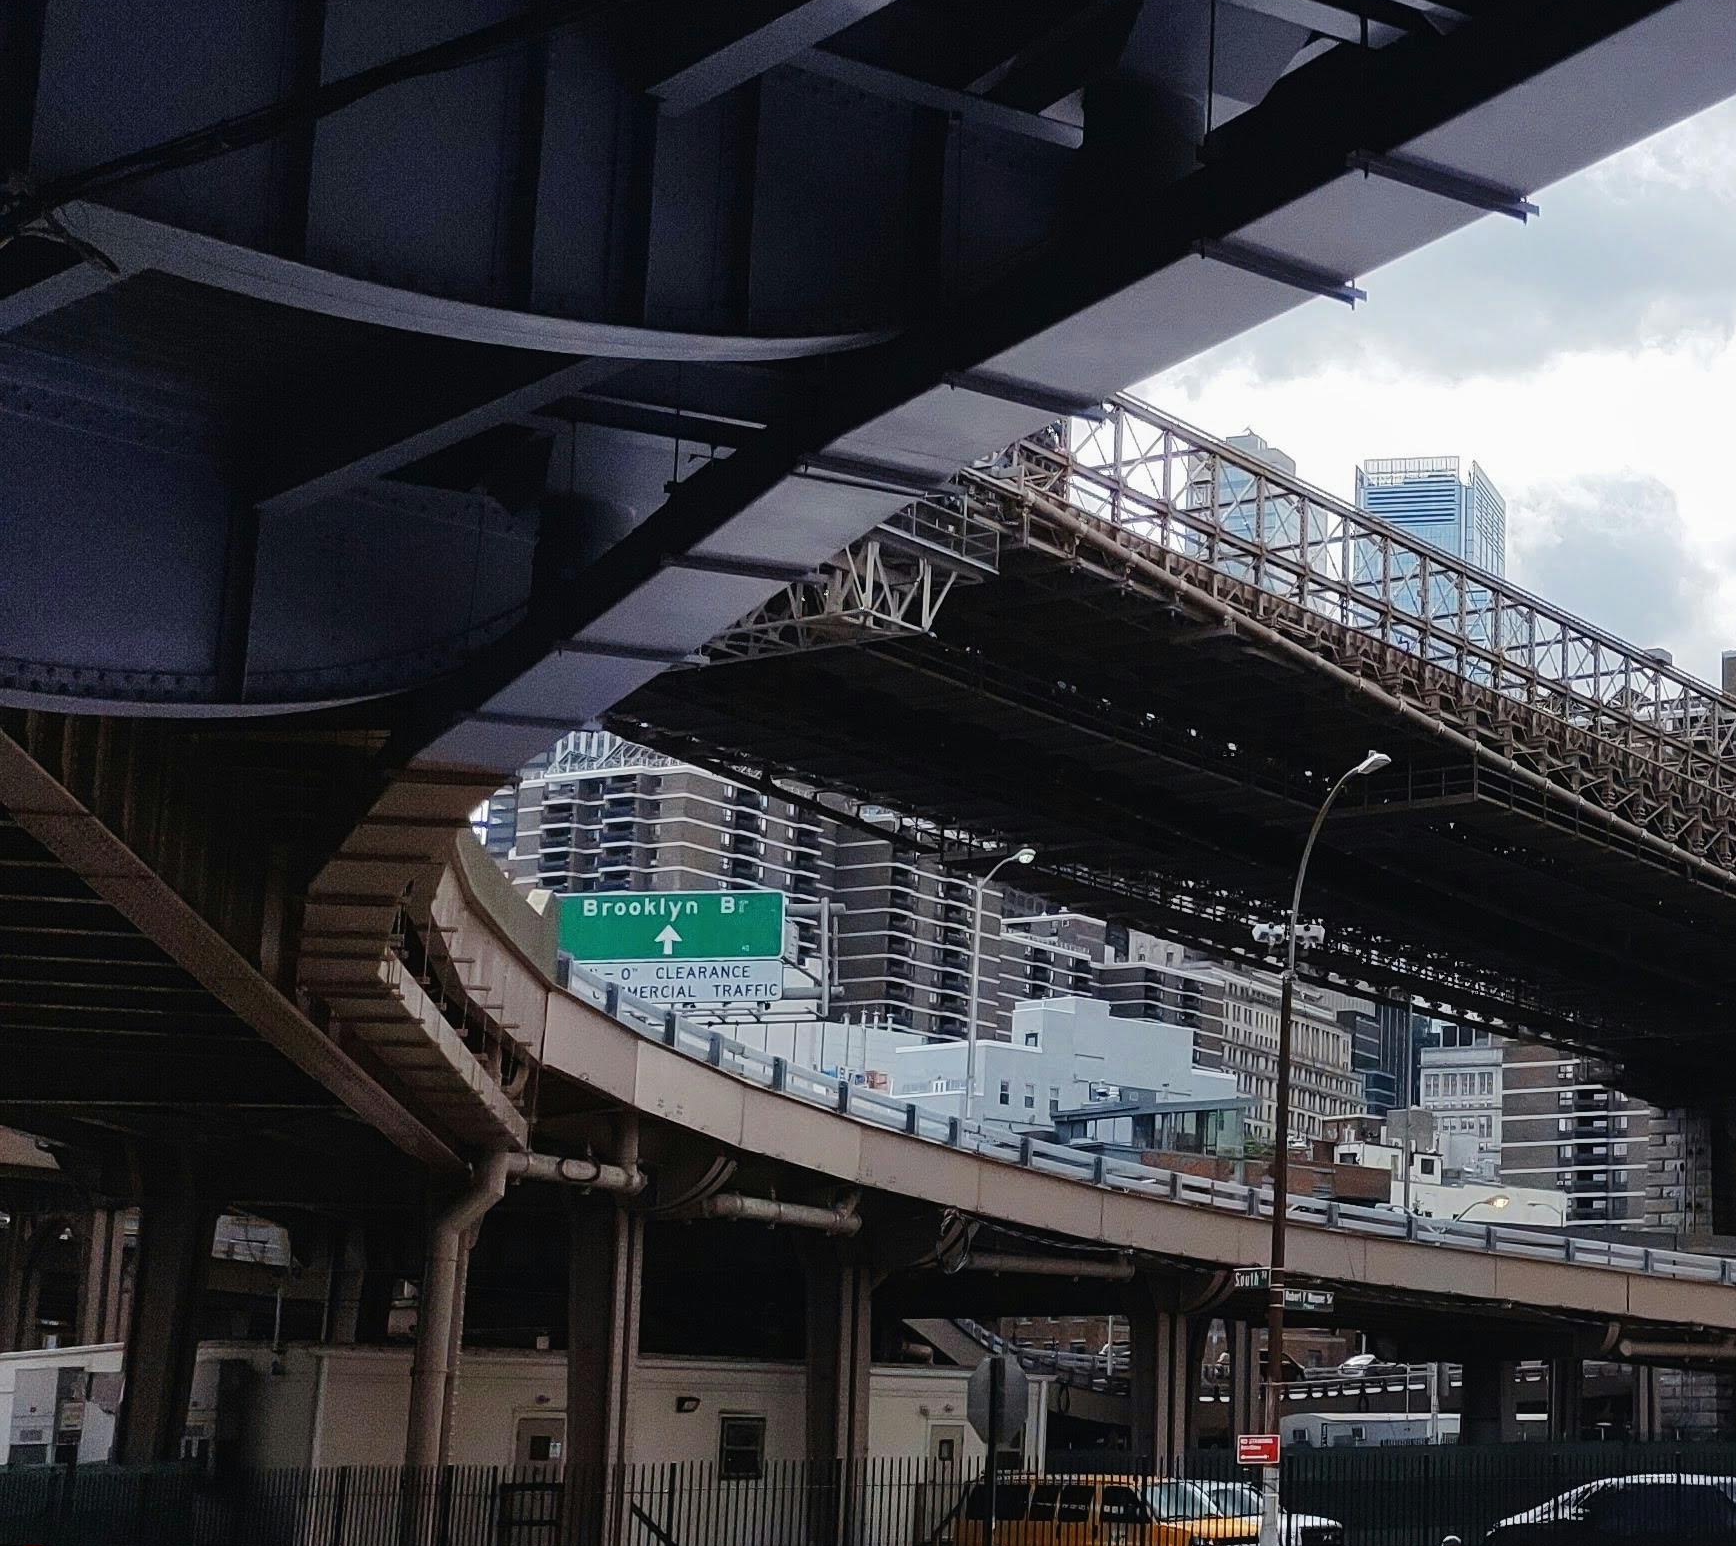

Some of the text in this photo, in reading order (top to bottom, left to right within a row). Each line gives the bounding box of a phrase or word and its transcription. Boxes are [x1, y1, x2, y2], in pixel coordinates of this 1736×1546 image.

[583, 896, 749, 922] Brooklyn Br
[655, 966, 751, 980] CLEARANCE
[711, 983, 778, 998] TRAFFIC
[1235, 1271, 1259, 1287] South
